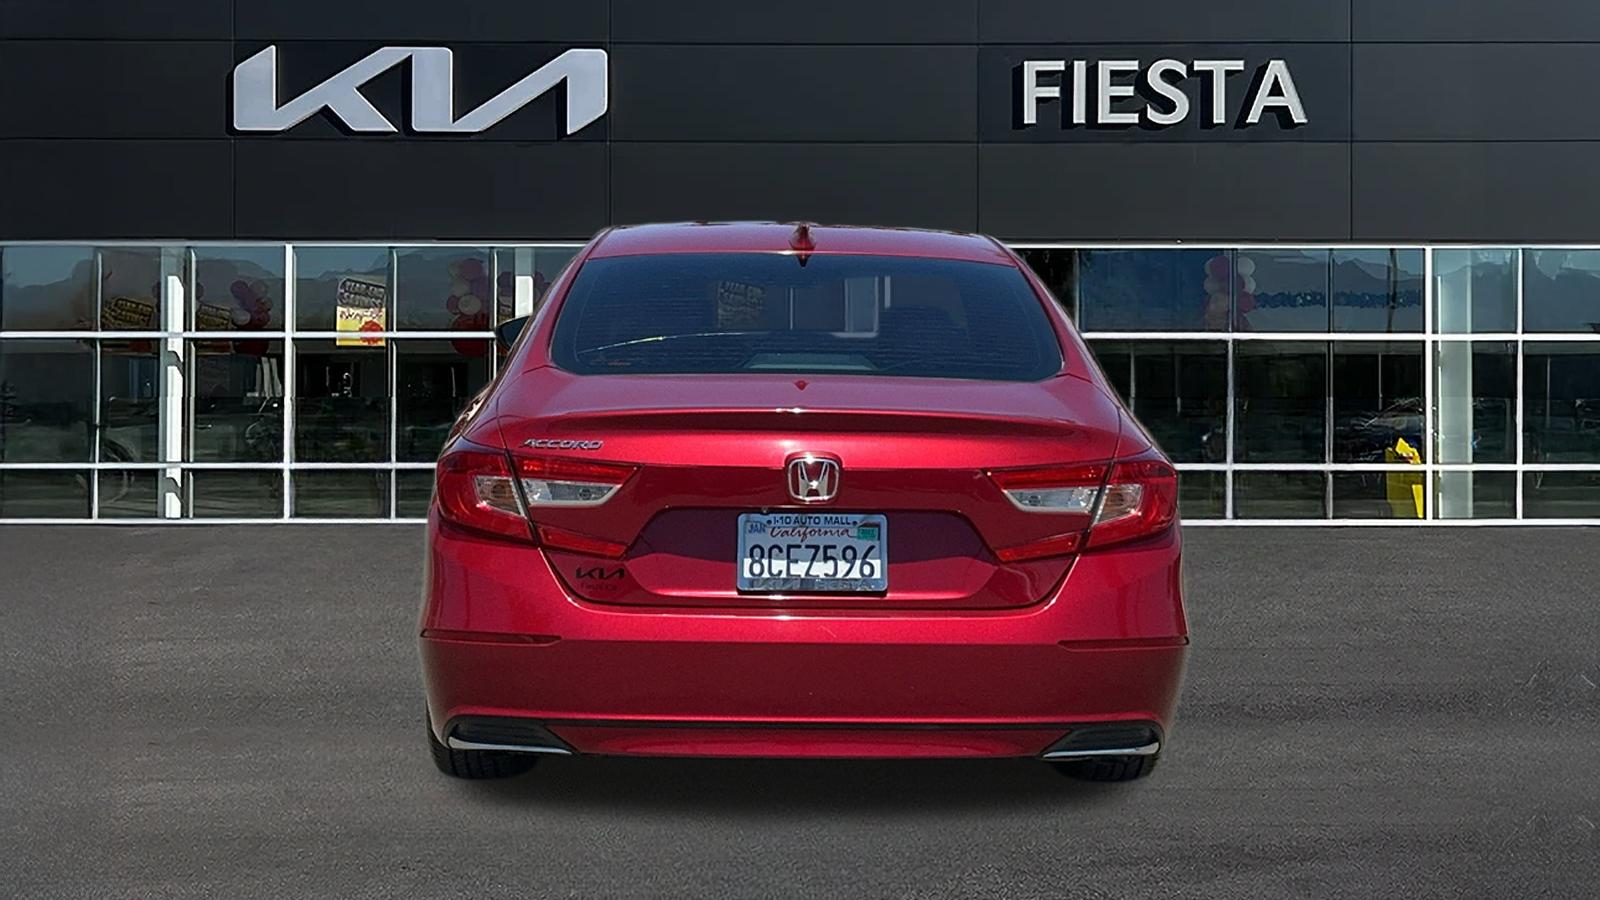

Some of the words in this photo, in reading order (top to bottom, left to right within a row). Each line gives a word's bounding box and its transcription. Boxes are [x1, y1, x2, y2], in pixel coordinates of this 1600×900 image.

[233, 44, 608, 135] KIA
[1022, 58, 1308, 125] FIESTA
[523, 438, 603, 449] ACCORD
[793, 516, 821, 526] AUTO
[824, 516, 850, 526] MALL
[770, 526, 851, 542] California
[749, 544, 876, 578] 8CEZ596
[575, 566, 625, 580] KIA
